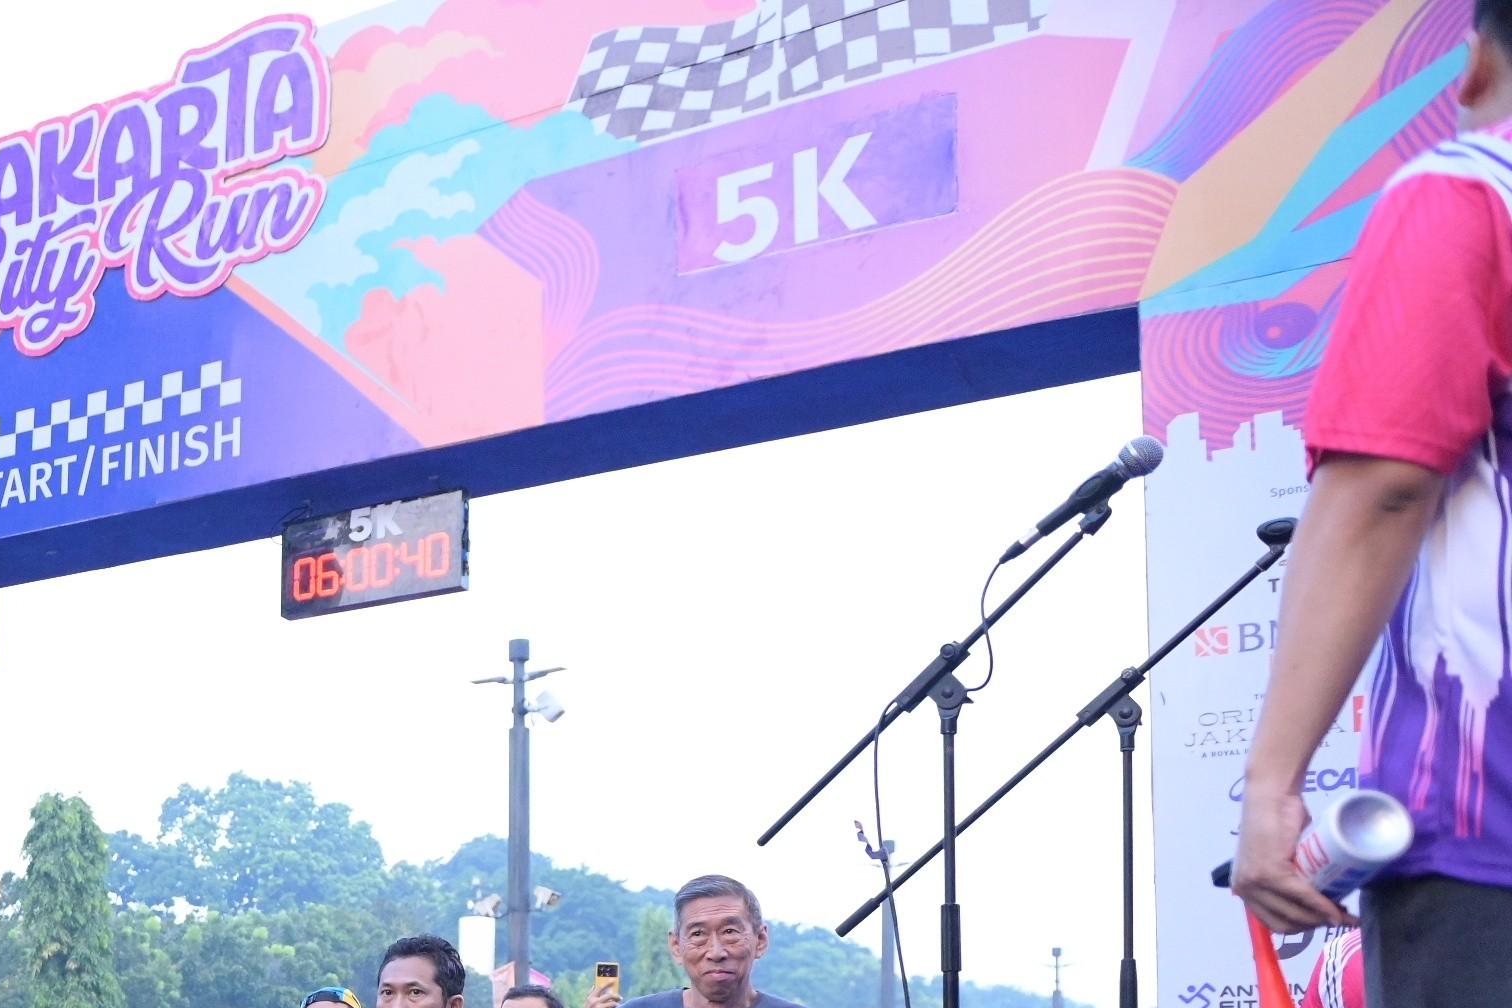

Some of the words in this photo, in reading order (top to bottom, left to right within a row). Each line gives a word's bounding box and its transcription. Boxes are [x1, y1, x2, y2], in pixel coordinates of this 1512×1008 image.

[106, 175, 311, 290] Run
[713, 131, 877, 263] 5K
[349, 500, 403, 542] 5K
